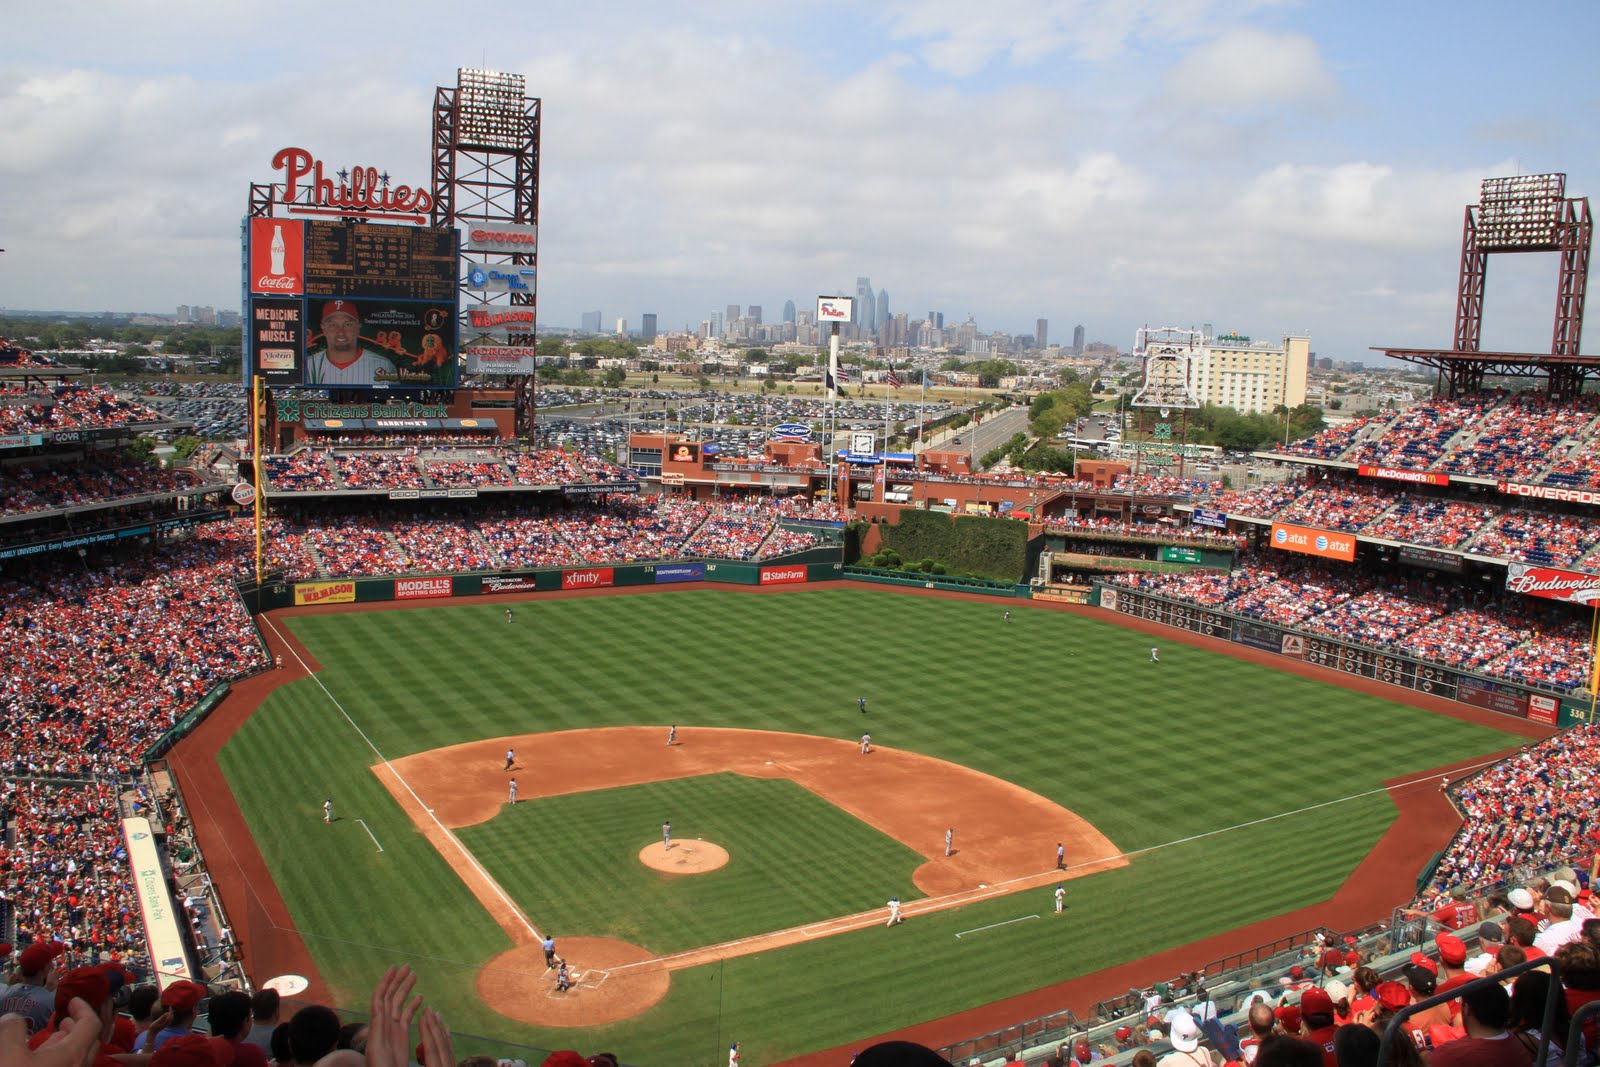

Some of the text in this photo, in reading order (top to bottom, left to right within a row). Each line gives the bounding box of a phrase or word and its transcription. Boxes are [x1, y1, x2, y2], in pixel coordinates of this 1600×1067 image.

[272, 147, 433, 213] Phillies
[487, 231, 535, 244] TOYOTA
[258, 275, 297, 289] Coca-Cola
[260, 330, 296, 342] MUSCLE
[467, 347, 535, 356] HORIZON
[303, 402, 448, 418] Citizens Bank Park
[55, 432, 79, 441] GOYA
[1122, 441, 1201, 455] Citizens Bank
[1148, 454, 1173, 465] Park
[1376, 469, 1427, 483] McDonald's
[613, 485, 637, 493] Hospitals
[1507, 483, 1600, 504] POWERADE
[62, 538, 90, 548] Opportunity
[1288, 533, 1308, 545] at&t
[1329, 540, 1350, 552] at&t
[566, 571, 600, 585] xfinity
[397, 579, 451, 591] MODELL'S
[489, 582, 536, 592] Budweiser
[1570, 708, 1584, 720] 330
